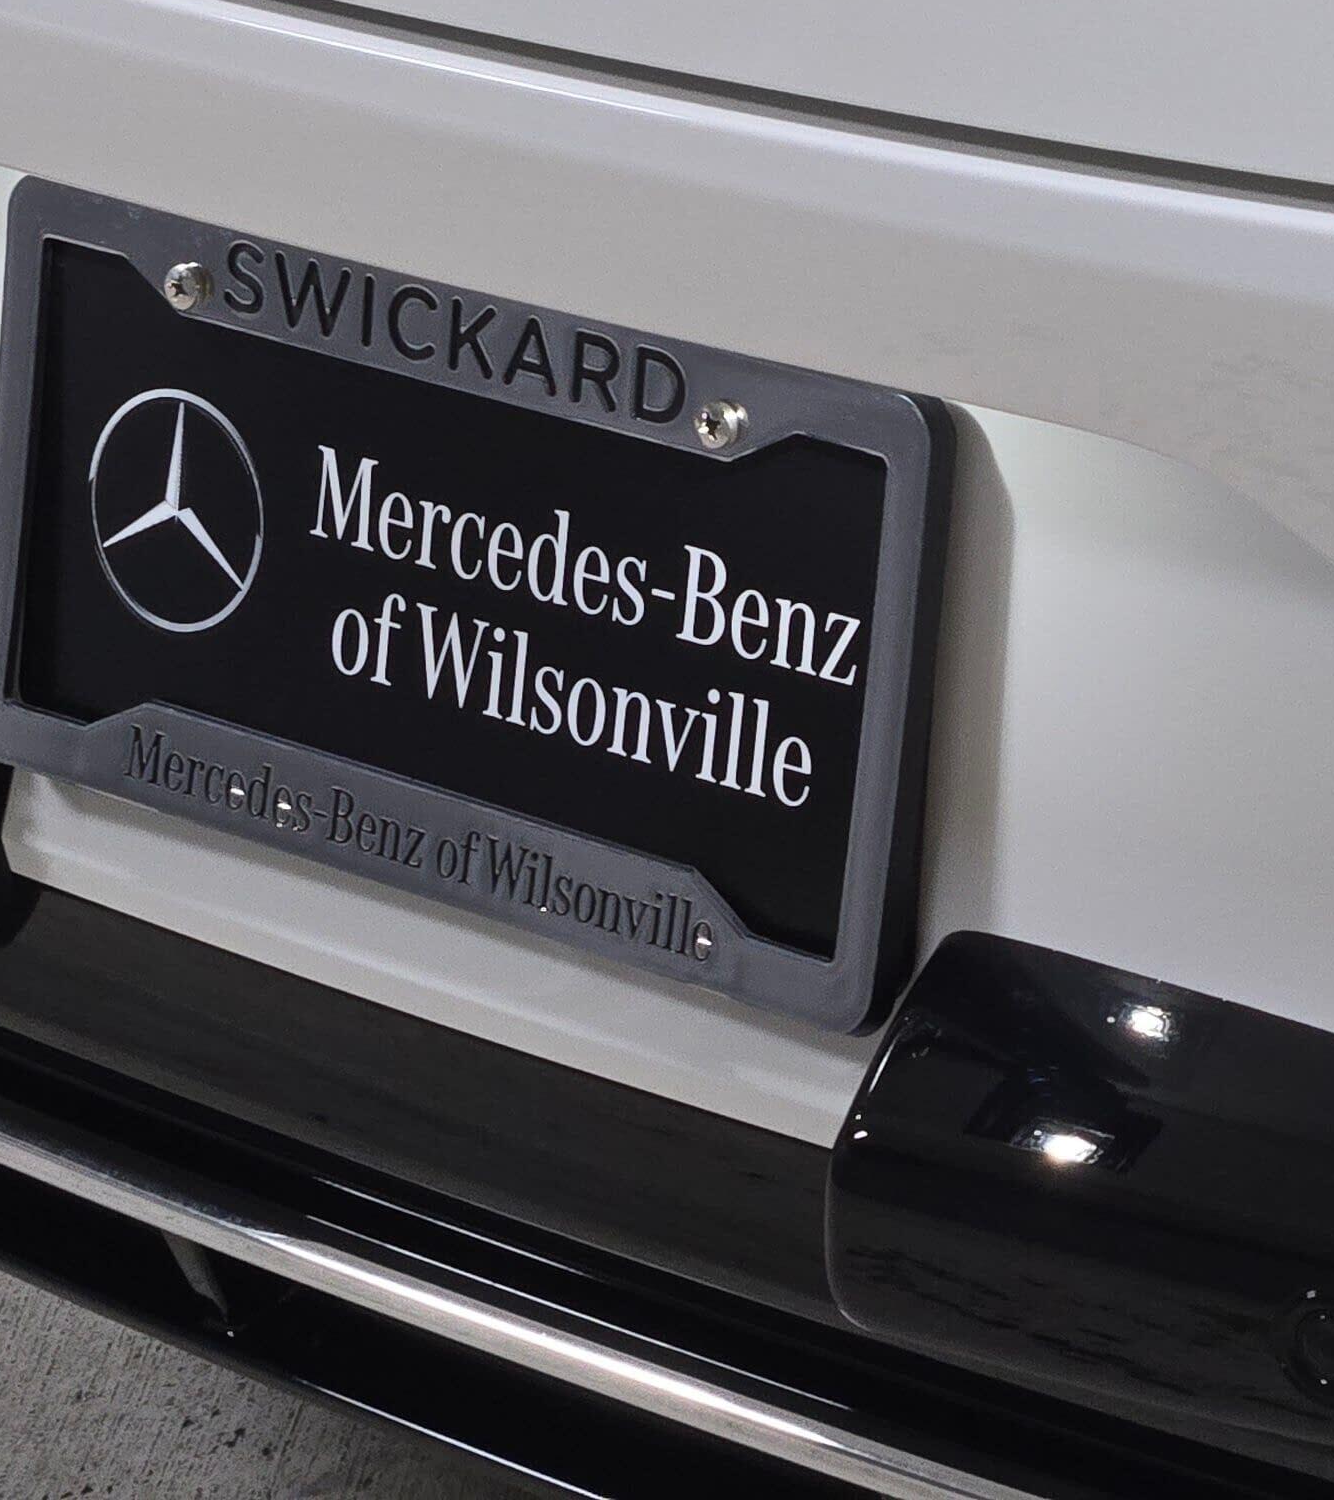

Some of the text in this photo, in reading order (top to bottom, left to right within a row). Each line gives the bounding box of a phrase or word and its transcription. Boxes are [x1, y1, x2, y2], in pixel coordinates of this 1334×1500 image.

[223, 241, 688, 424] SWICKARD
[309, 445, 862, 686] Mercedes-Benz
[332, 594, 812, 808] of Wilsonville
[124, 725, 715, 964] Mercedes-Benz of Wilsonville
